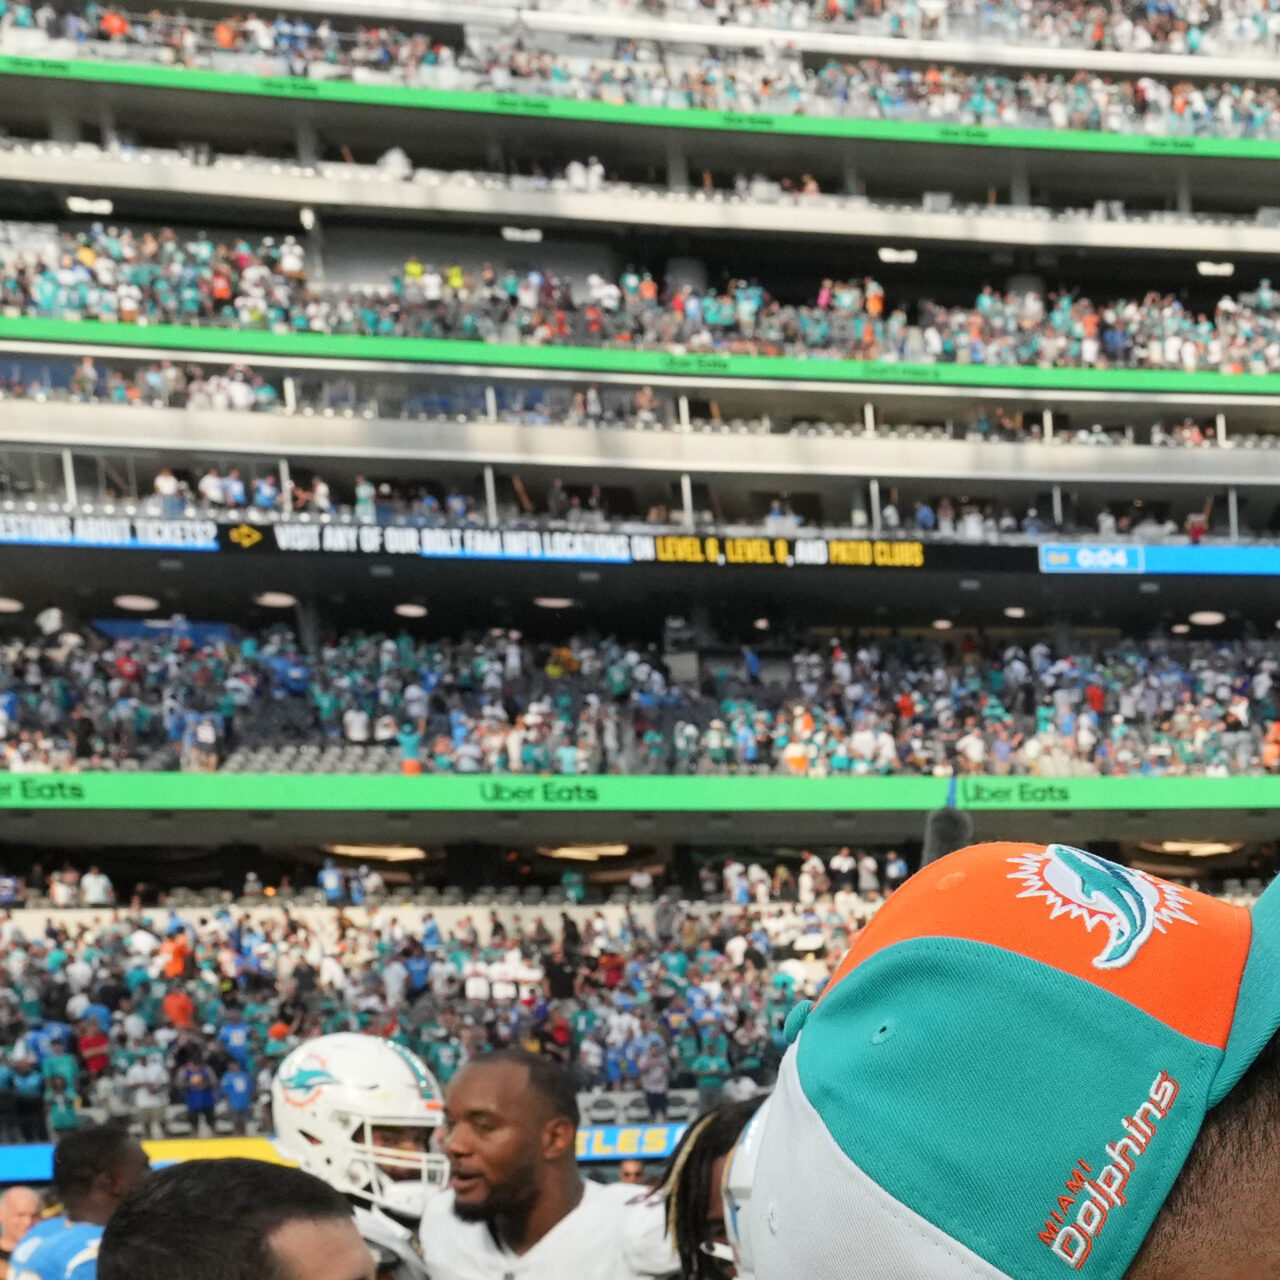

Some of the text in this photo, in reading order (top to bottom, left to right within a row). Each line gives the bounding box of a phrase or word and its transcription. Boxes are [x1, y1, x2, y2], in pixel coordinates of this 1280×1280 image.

[19, 779, 85, 801] Eats
[479, 782, 599, 803] Uber Eats
[1019, 782, 1071, 802] Eats
[1052, 1070, 1179, 1270] Dolphins
[1037, 1158, 1092, 1247] MIAMI
